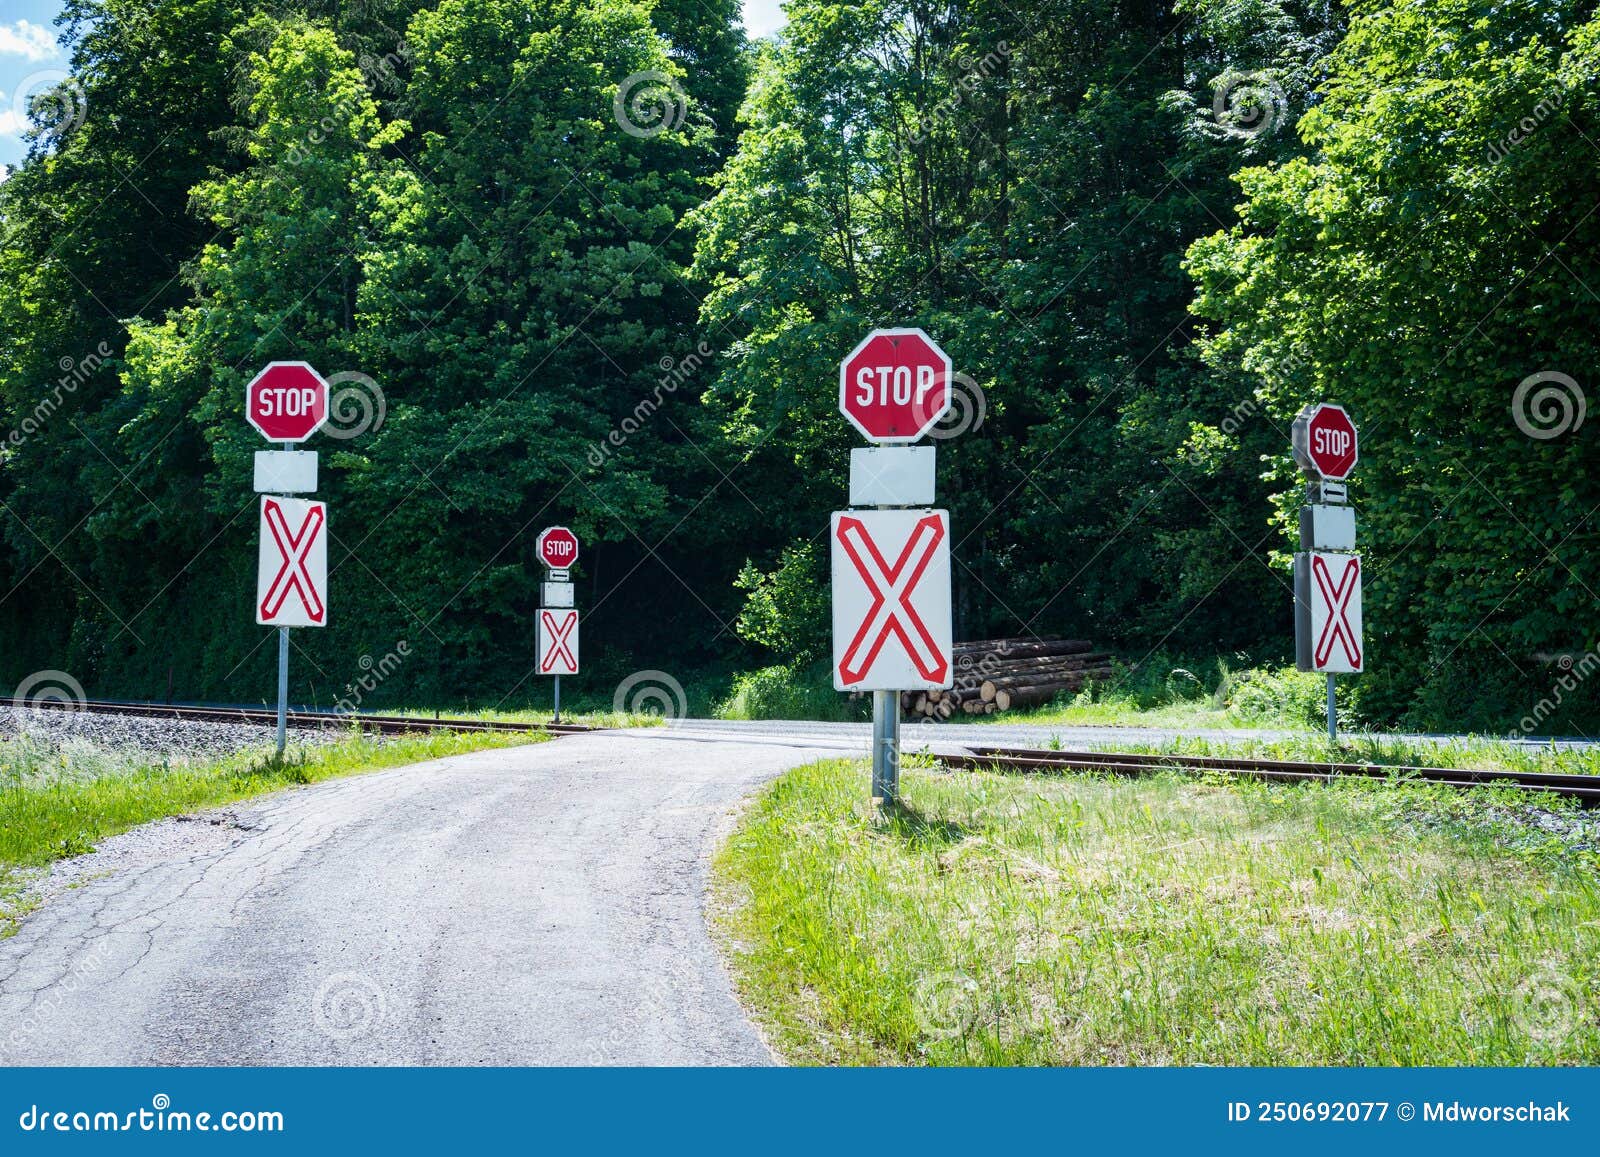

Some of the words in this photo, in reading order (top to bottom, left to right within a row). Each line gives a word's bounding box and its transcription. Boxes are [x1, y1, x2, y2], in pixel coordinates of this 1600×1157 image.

[856, 365, 935, 407] STOP
[259, 388, 316, 416] STOP
[1315, 427, 1350, 457] STOP
[546, 540, 573, 556] STOP
